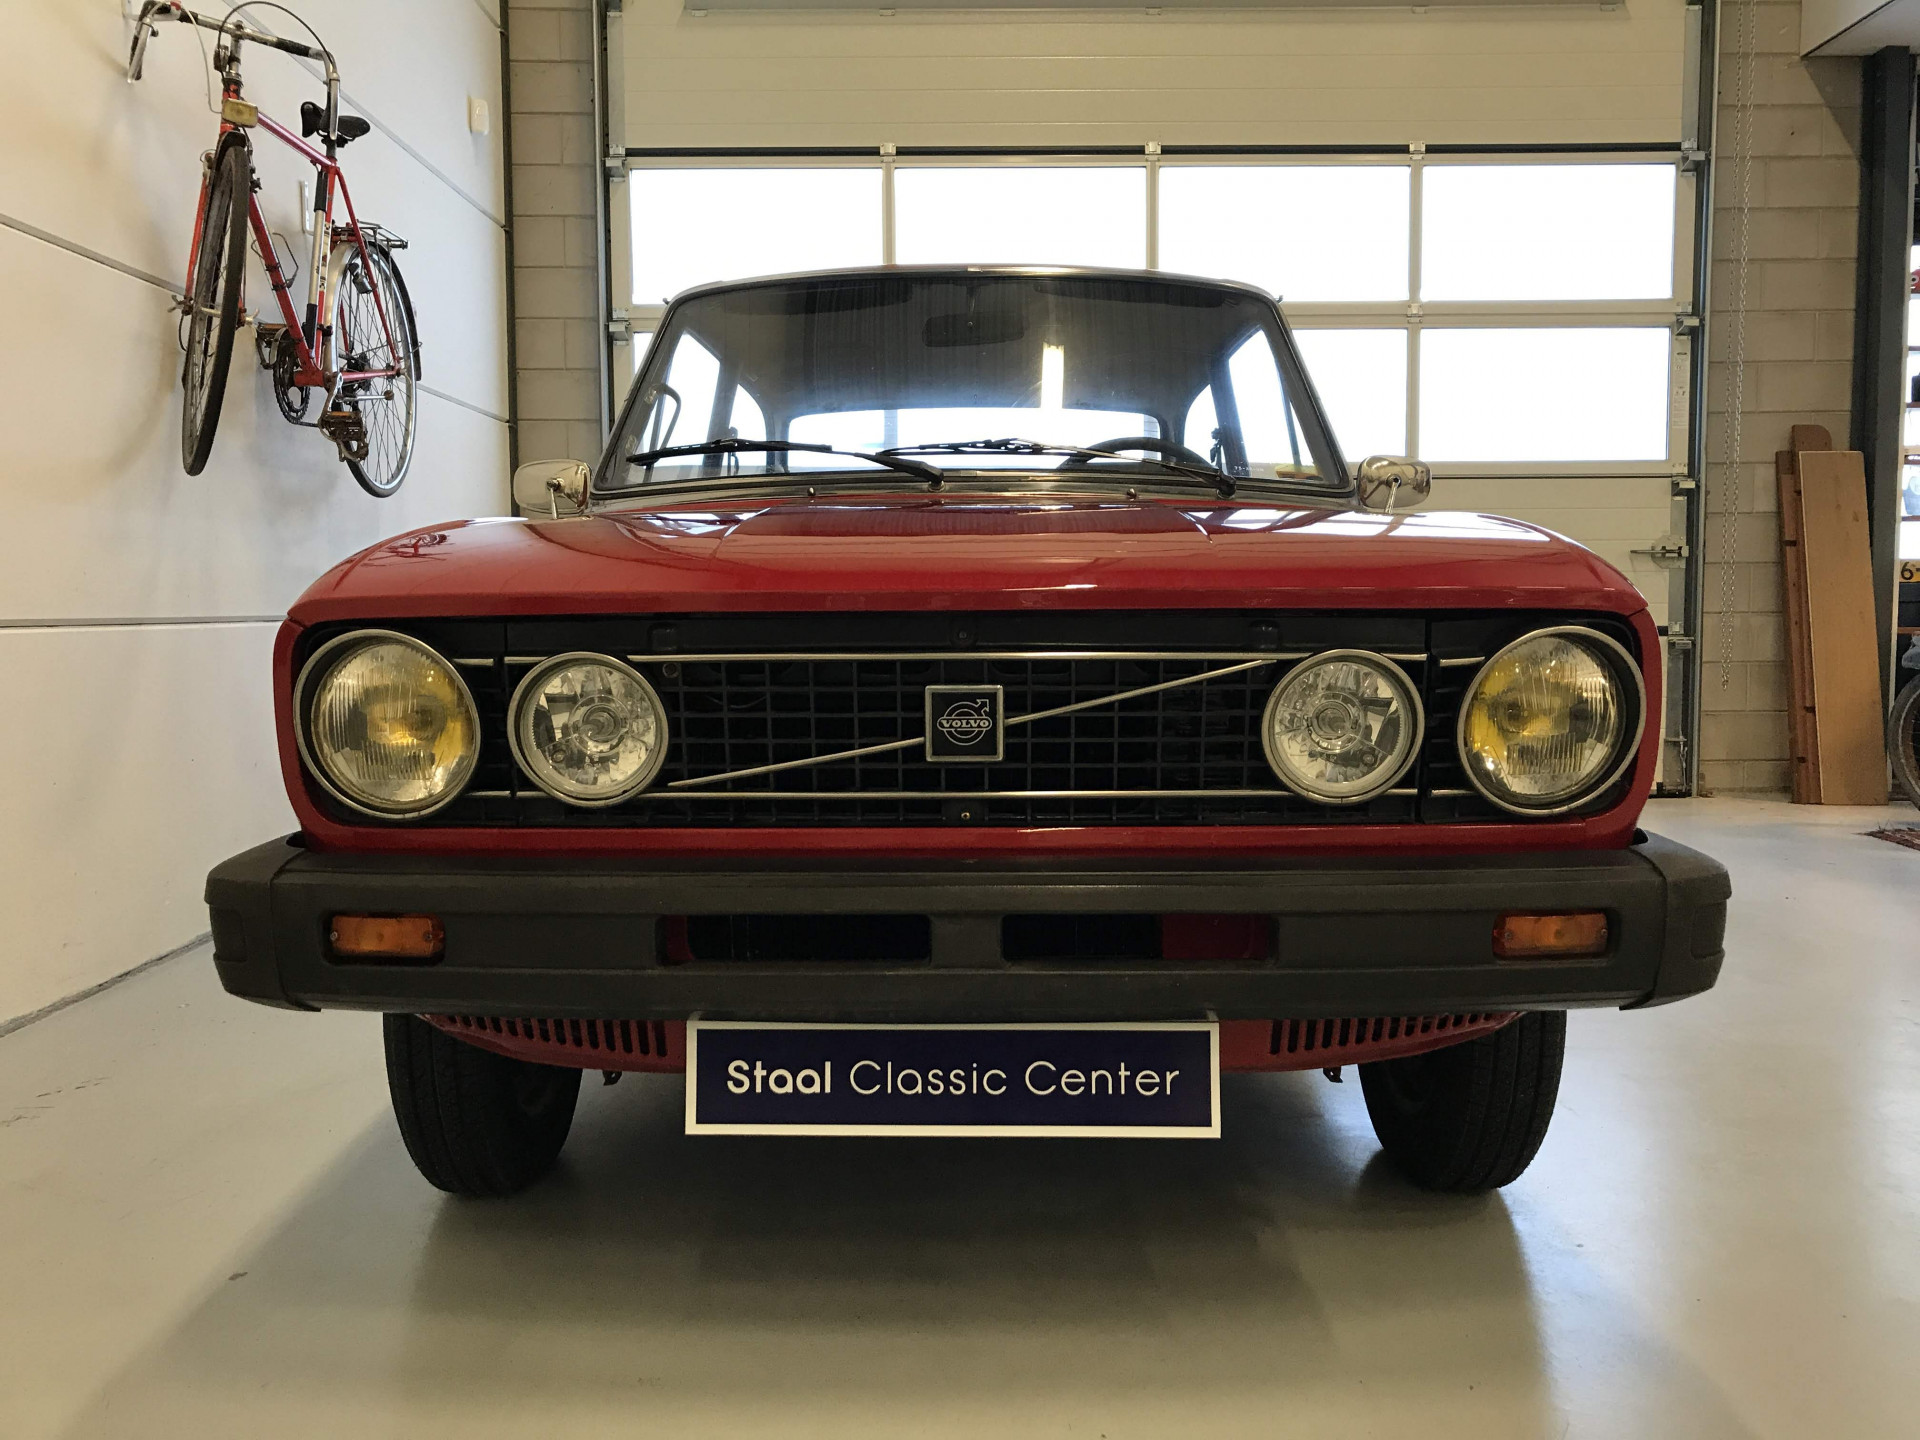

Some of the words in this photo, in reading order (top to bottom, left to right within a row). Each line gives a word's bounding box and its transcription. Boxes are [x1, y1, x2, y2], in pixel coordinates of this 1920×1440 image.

[940, 719, 989, 728] VOLVO
[727, 1060, 831, 1094] Staal
[850, 1061, 1006, 1095] Classic
[1025, 1061, 1179, 1095] Center
